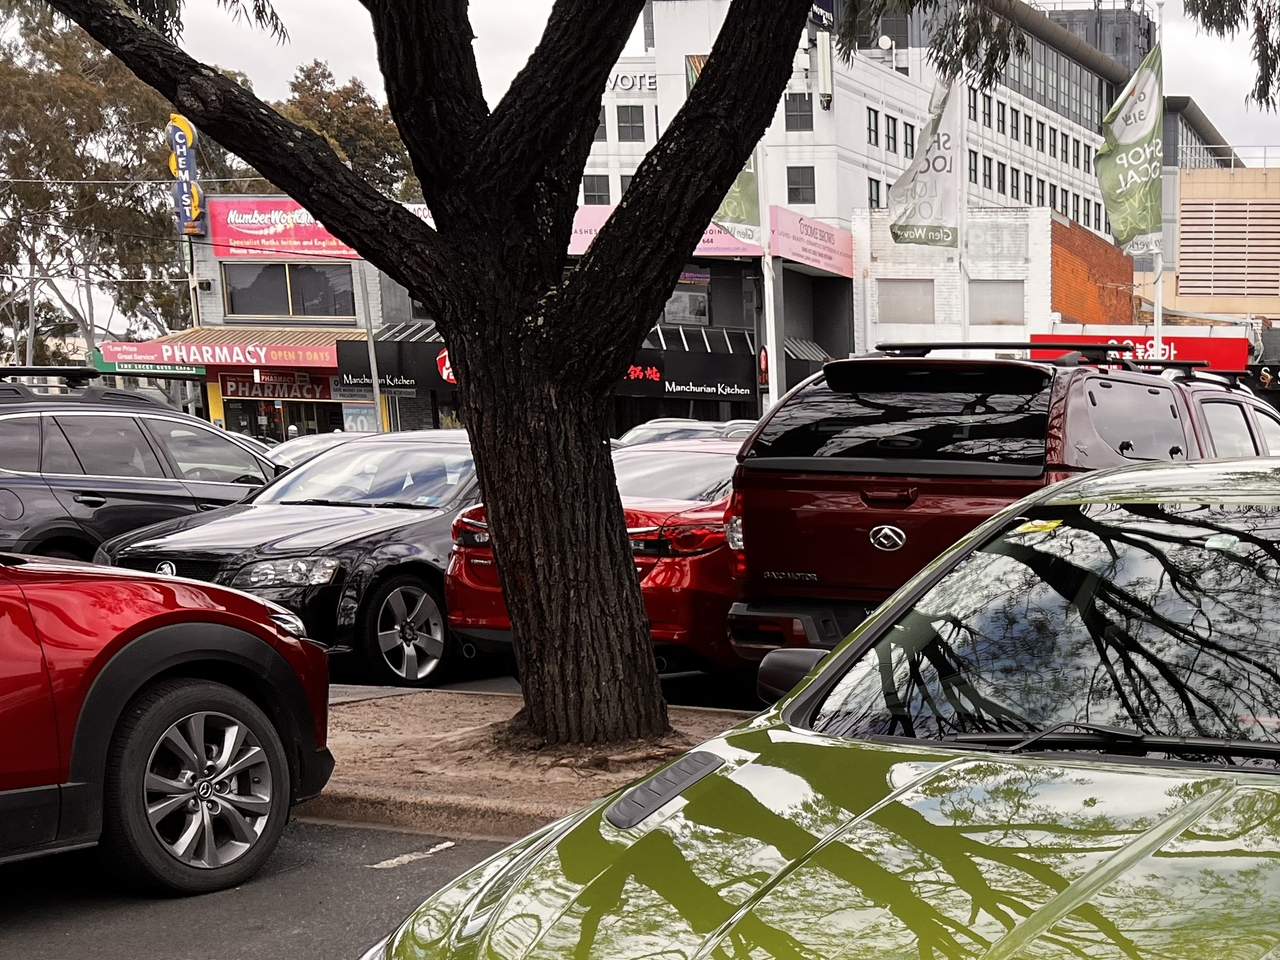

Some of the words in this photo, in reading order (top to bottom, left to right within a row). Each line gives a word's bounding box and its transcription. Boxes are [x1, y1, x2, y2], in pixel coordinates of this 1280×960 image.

[607, 73, 657, 90] VOTE
[175, 131, 192, 218] CHEMIST
[314, 239, 337, 247] English
[161, 345, 267, 364] PHARMACY
[270, 350, 295, 360] OPEN
[298, 351, 303, 360] 7
[306, 351, 330, 361] DAYS
[385, 374, 415, 386] Kitchen
[624, 364, 661, 381] 锅炖
[226, 382, 323, 398] PHARMACY
[665, 381, 716, 394] Manchurian
[718, 383, 750, 395] Kitchen
[787, 572, 818, 581] MOTOR
